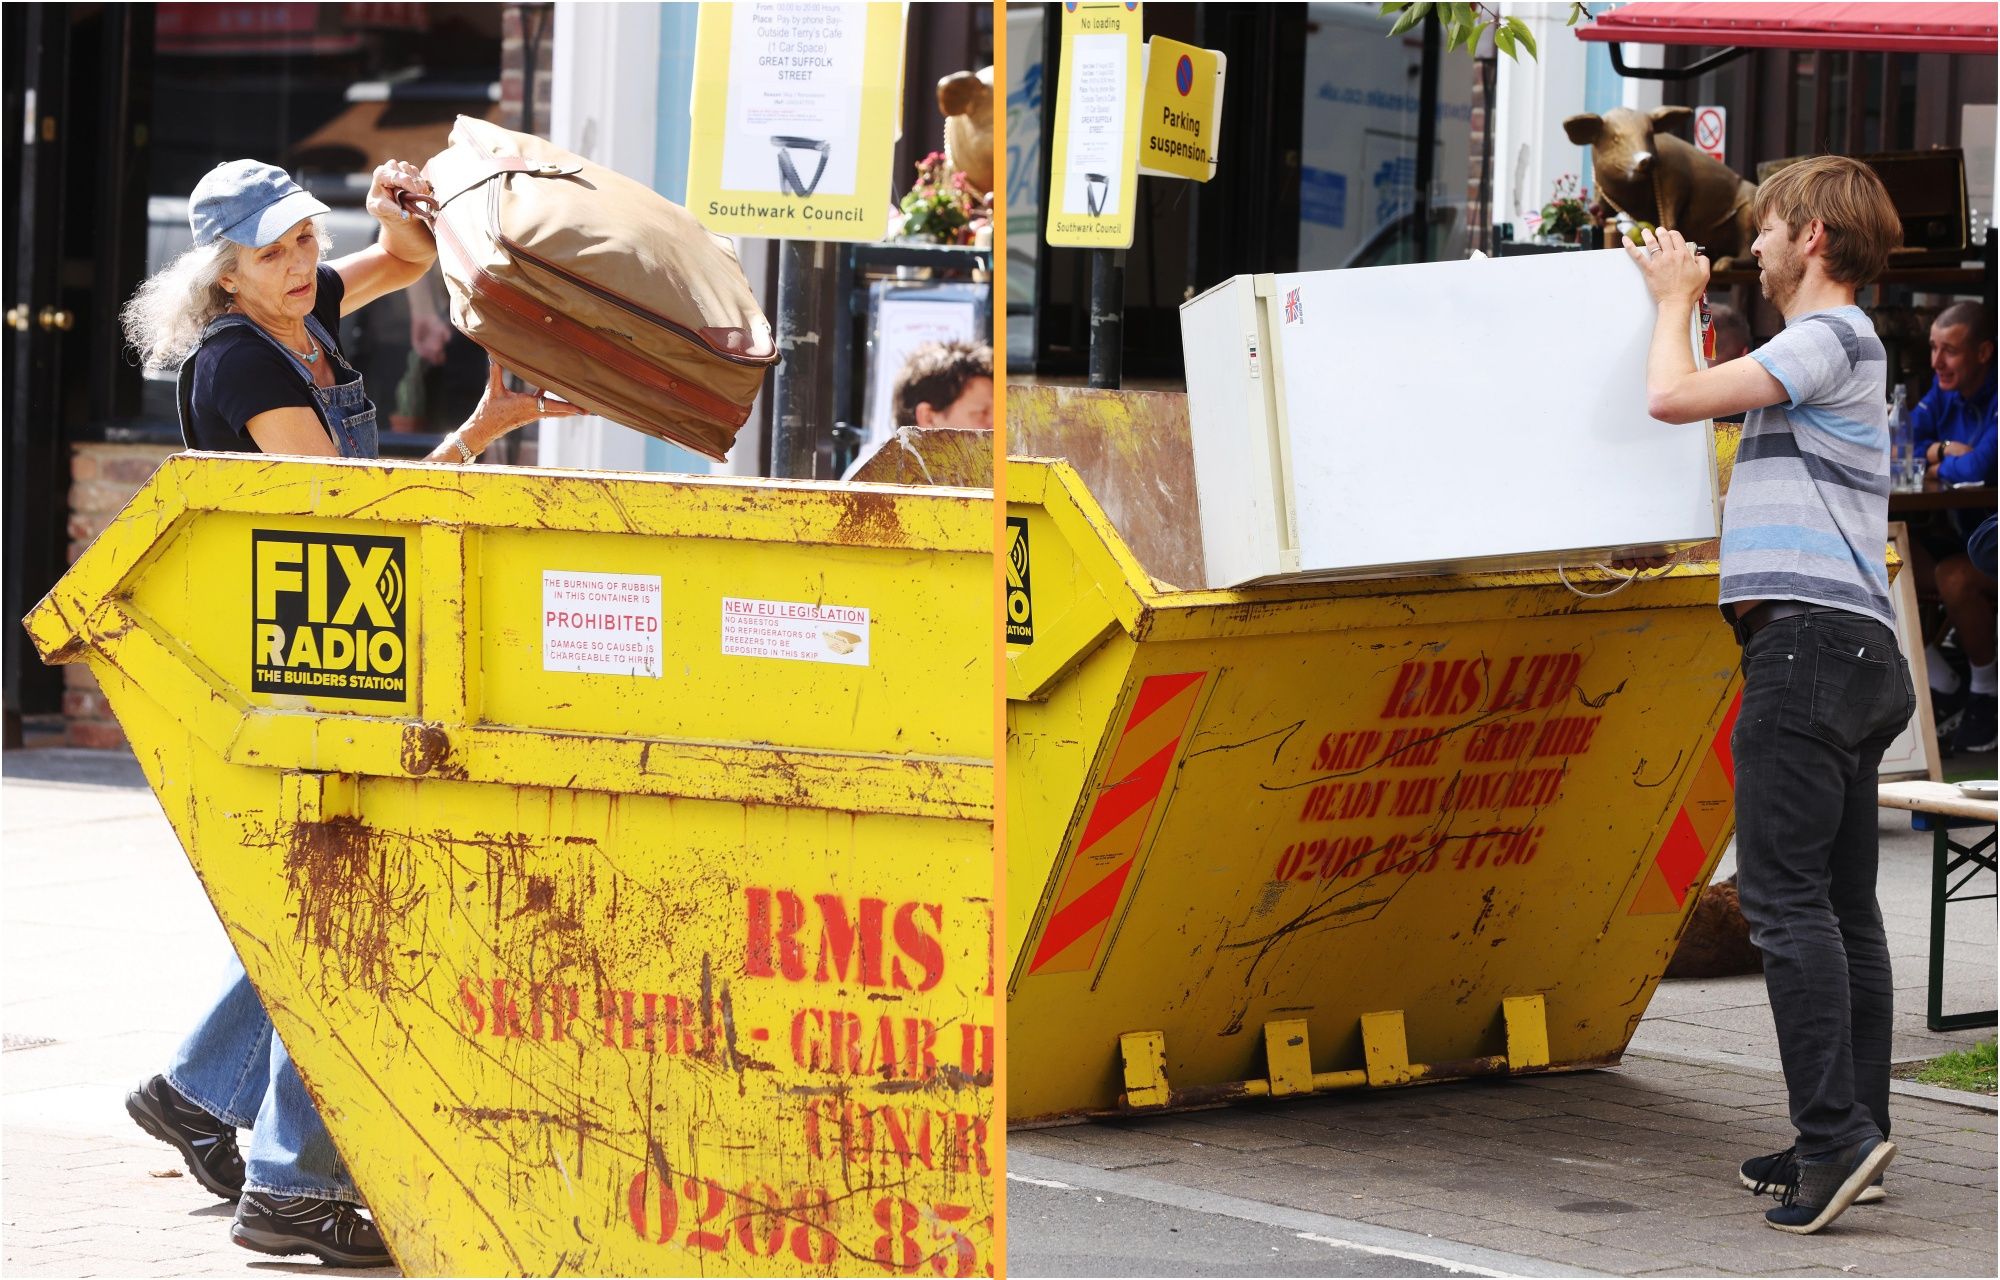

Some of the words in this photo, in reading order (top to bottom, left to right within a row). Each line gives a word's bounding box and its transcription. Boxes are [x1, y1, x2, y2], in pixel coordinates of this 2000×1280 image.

[1081, 18, 1090, 29] No
[1093, 17, 1120, 30] loading
[757, 26, 789, 38] Outside
[779, 41, 794, 53] Car
[796, 42, 827, 54] Space)
[758, 56, 789, 66] GREAT
[792, 57, 833, 67] SUFFOLK
[778, 70, 813, 80] STREET
[1163, 106, 1200, 137] Parking
[1150, 135, 1206, 163] suspension
[709, 202, 795, 219] Southwark
[803, 205, 863, 221] Council
[1056, 222, 1093, 234] Southwark
[1096, 222, 1122, 234] Council
[257, 541, 396, 627] FIX
[544, 578, 560, 587] THE
[564, 579, 604, 590] BURNING
[606, 582, 619, 590] OF
[621, 583, 660, 592] RUBBISH
[554, 591, 563, 599] IN
[565, 592, 585, 600] THIS
[588, 593, 639, 603] CONTAINER
[642, 595, 650, 604] IS
[725, 601, 753, 613] NEW
[758, 603, 775, 615] EU
[780, 605, 865, 622] LEGISLATION
[546, 611, 658, 632] PROHIBITED
[738, 618, 779, 627] ASBESTOS
[738, 627, 802, 639] REFRIGERATORS
[1006, 624, 1031, 637] ATION
[256, 623, 403, 674] RADIO
[550, 640, 588, 650] DAMAGE
[591, 642, 604, 650] SO
[606, 642, 643, 652] CAUSED
[646, 644, 654, 653] IS
[725, 636, 766, 645] FREEZERS
[768, 638, 777, 646] TO
[780, 639, 790, 647] BE
[550, 651, 610, 662] CHARGEABLE
[628, 656, 655, 664] HIRER
[725, 646, 768, 655] DEPOSITED
[801, 651, 818, 659] SKIP
[256, 669, 281, 682] THE
[284, 671, 347, 687] BUILDERS
[349, 676, 403, 691] STATION
[1380, 657, 1493, 719] RMS
[1488, 652, 1582, 713] LTD
[1311, 730, 1382, 771] SKIP
[1376, 726, 1446, 769] HIRE
[1464, 720, 1537, 764] GRAB
[1534, 715, 1602, 757] HIRE
[1298, 779, 1391, 823] READY
[1388, 776, 1445, 817] MIX
[1275, 836, 1374, 882] 0208
[1374, 832, 1448, 876] 853
[1452, 826, 1545, 870] 4796
[743, 886, 946, 992] RMS
[459, 977, 580, 1042] SKIP
[790, 1008, 937, 1081] GRAB
[628, 1168, 842, 1267] 0208
[873, 1195, 994, 1278] 85
